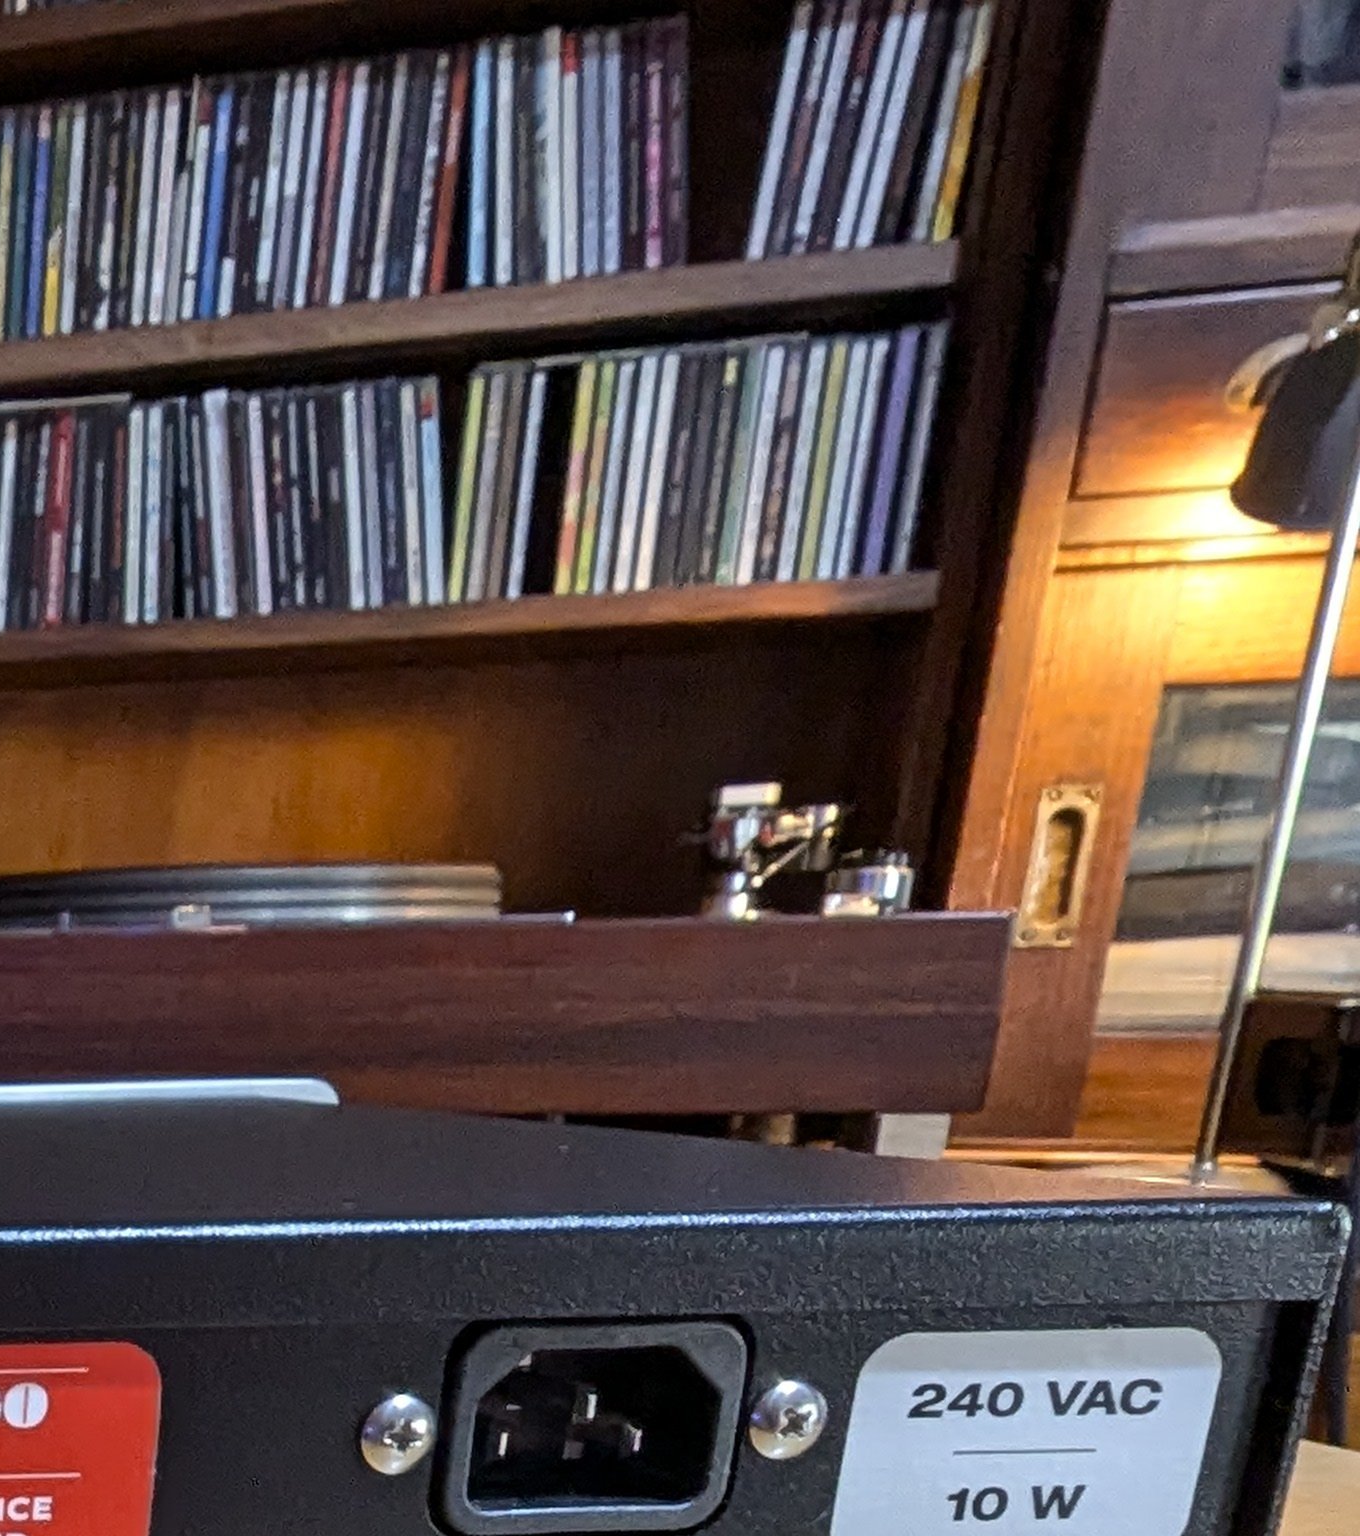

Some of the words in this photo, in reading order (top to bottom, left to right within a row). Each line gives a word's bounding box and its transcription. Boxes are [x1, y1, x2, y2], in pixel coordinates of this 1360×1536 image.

[907, 1383, 1023, 1418] 240
[1045, 1378, 1161, 1415] VAC
[944, 1487, 1008, 1522] 10
[1031, 1485, 1086, 1519] W
